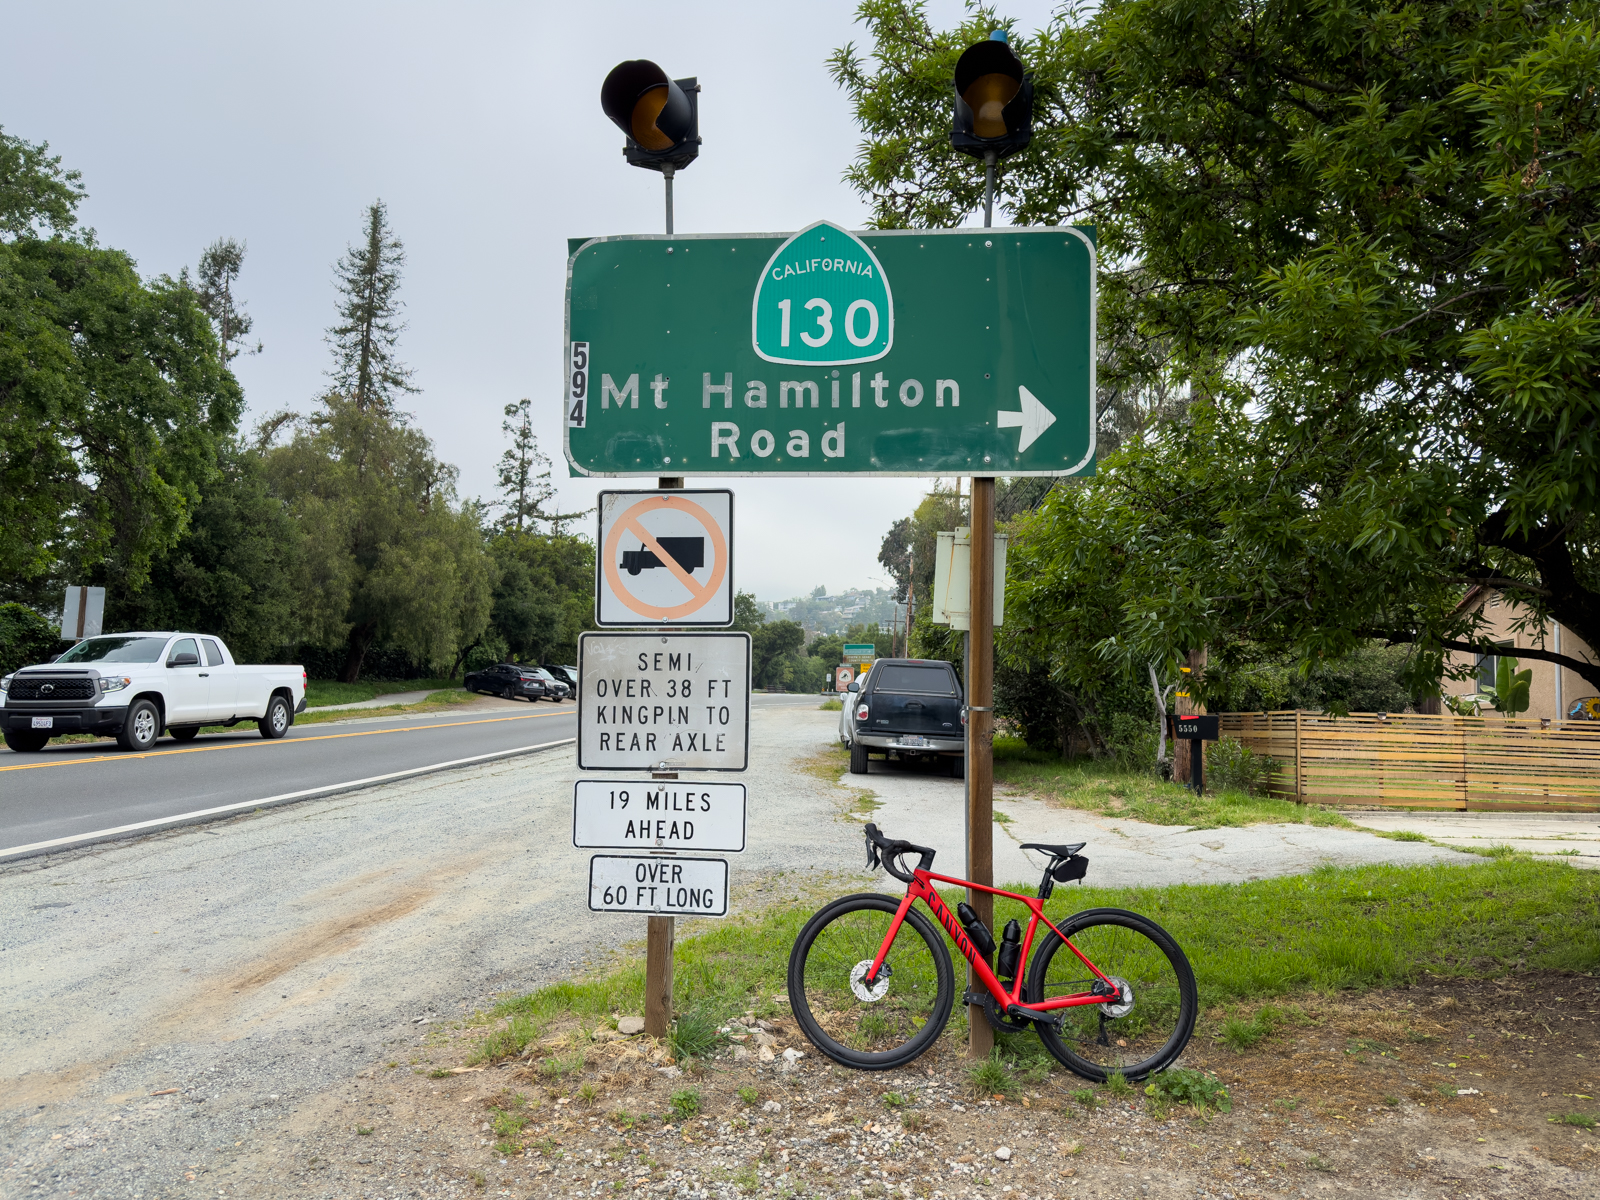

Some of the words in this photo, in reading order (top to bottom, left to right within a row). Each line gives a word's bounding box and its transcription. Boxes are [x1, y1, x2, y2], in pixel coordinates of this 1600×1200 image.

[771, 258, 874, 281] CALIFORNIA
[779, 298, 879, 348] 130
[570, 343, 588, 427] 594
[601, 373, 668, 409] Mt
[702, 370, 960, 409] Hamilton
[711, 421, 846, 458] Road
[637, 652, 692, 672] SEMI
[597, 679, 651, 698] OVER
[666, 679, 692, 698] 38
[708, 679, 732, 698] FT
[597, 705, 690, 725] KINGPIN
[706, 706, 730, 725] TO
[1179, 725, 1198, 733] 5550
[600, 732, 657, 752] REAR
[672, 732, 726, 752] AXLE
[610, 790, 630, 810] 19
[646, 791, 711, 812] MILES
[624, 819, 695, 840] AHEAD
[635, 863, 683, 884] OVER
[603, 885, 627, 906] 60
[636, 886, 658, 906] FT
[666, 887, 714, 909] LONG
[928, 891, 976, 965] CANYON
